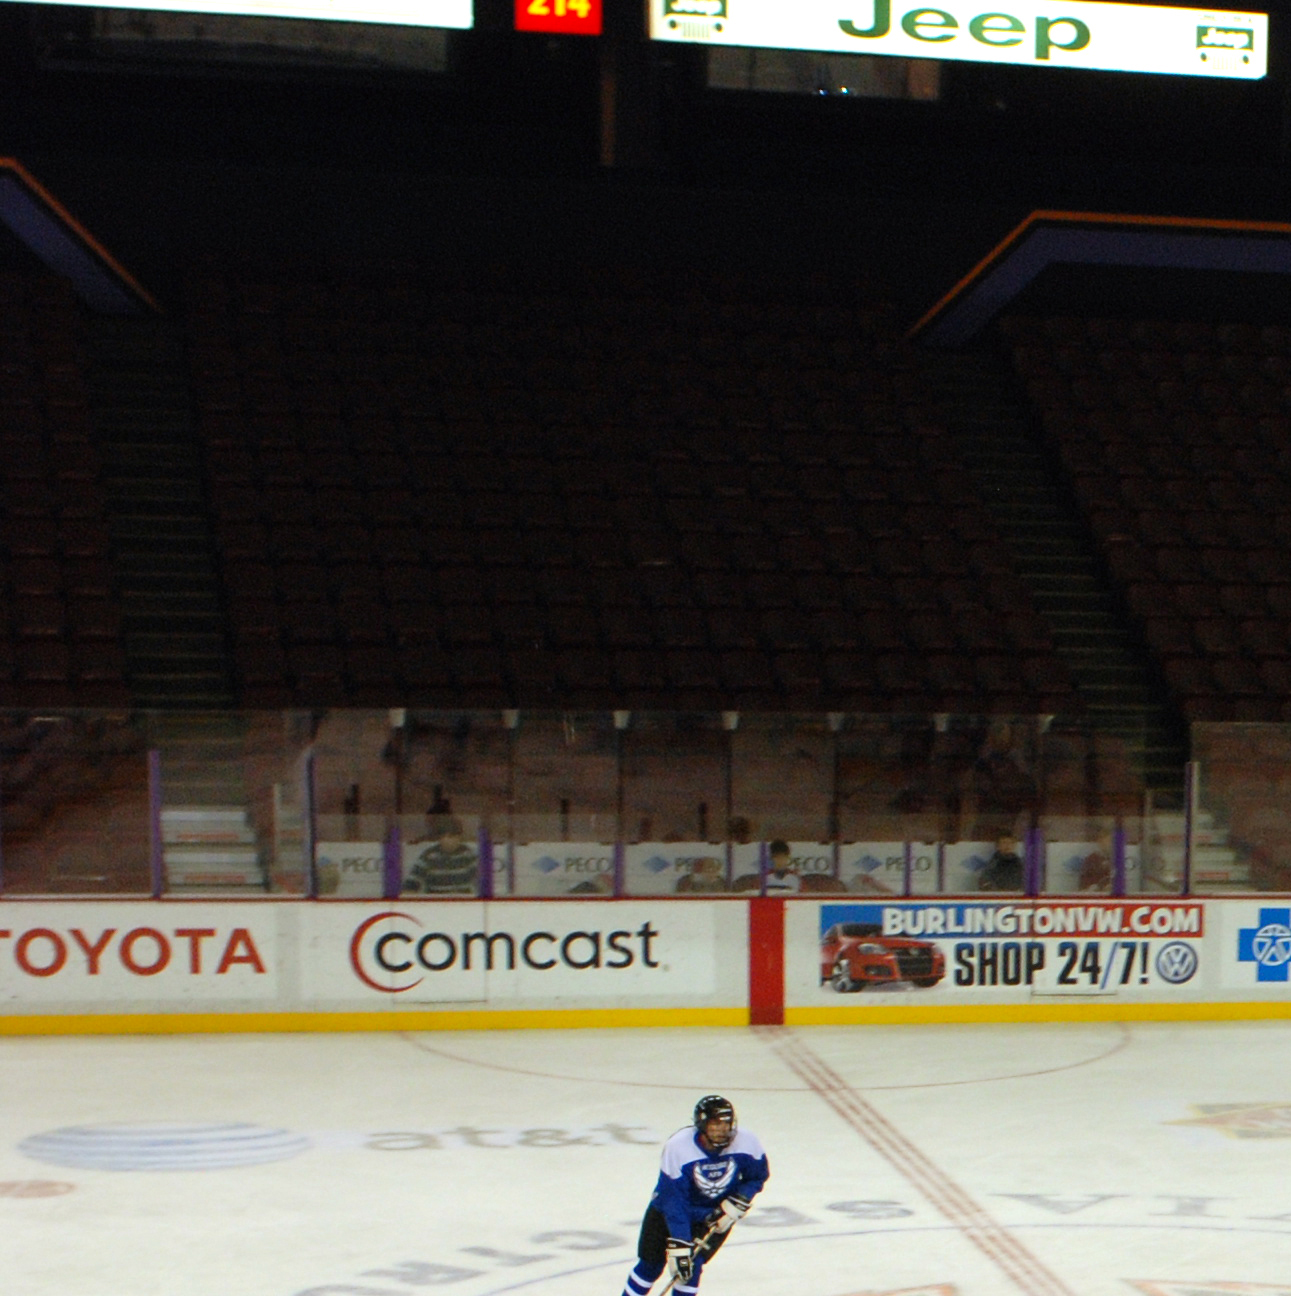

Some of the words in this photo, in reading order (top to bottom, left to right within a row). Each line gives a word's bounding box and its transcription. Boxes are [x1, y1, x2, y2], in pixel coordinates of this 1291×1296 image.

[838, 0, 1091, 60] Jeep
[882, 905, 1199, 936] BURLINGTONVW.COM
[0, 927, 267, 977] OYOTA
[373, 921, 660, 973] comcast
[954, 941, 1045, 987] SHOP
[1056, 940, 1149, 990] 24/7!
[364, 1123, 661, 1152] at&t
